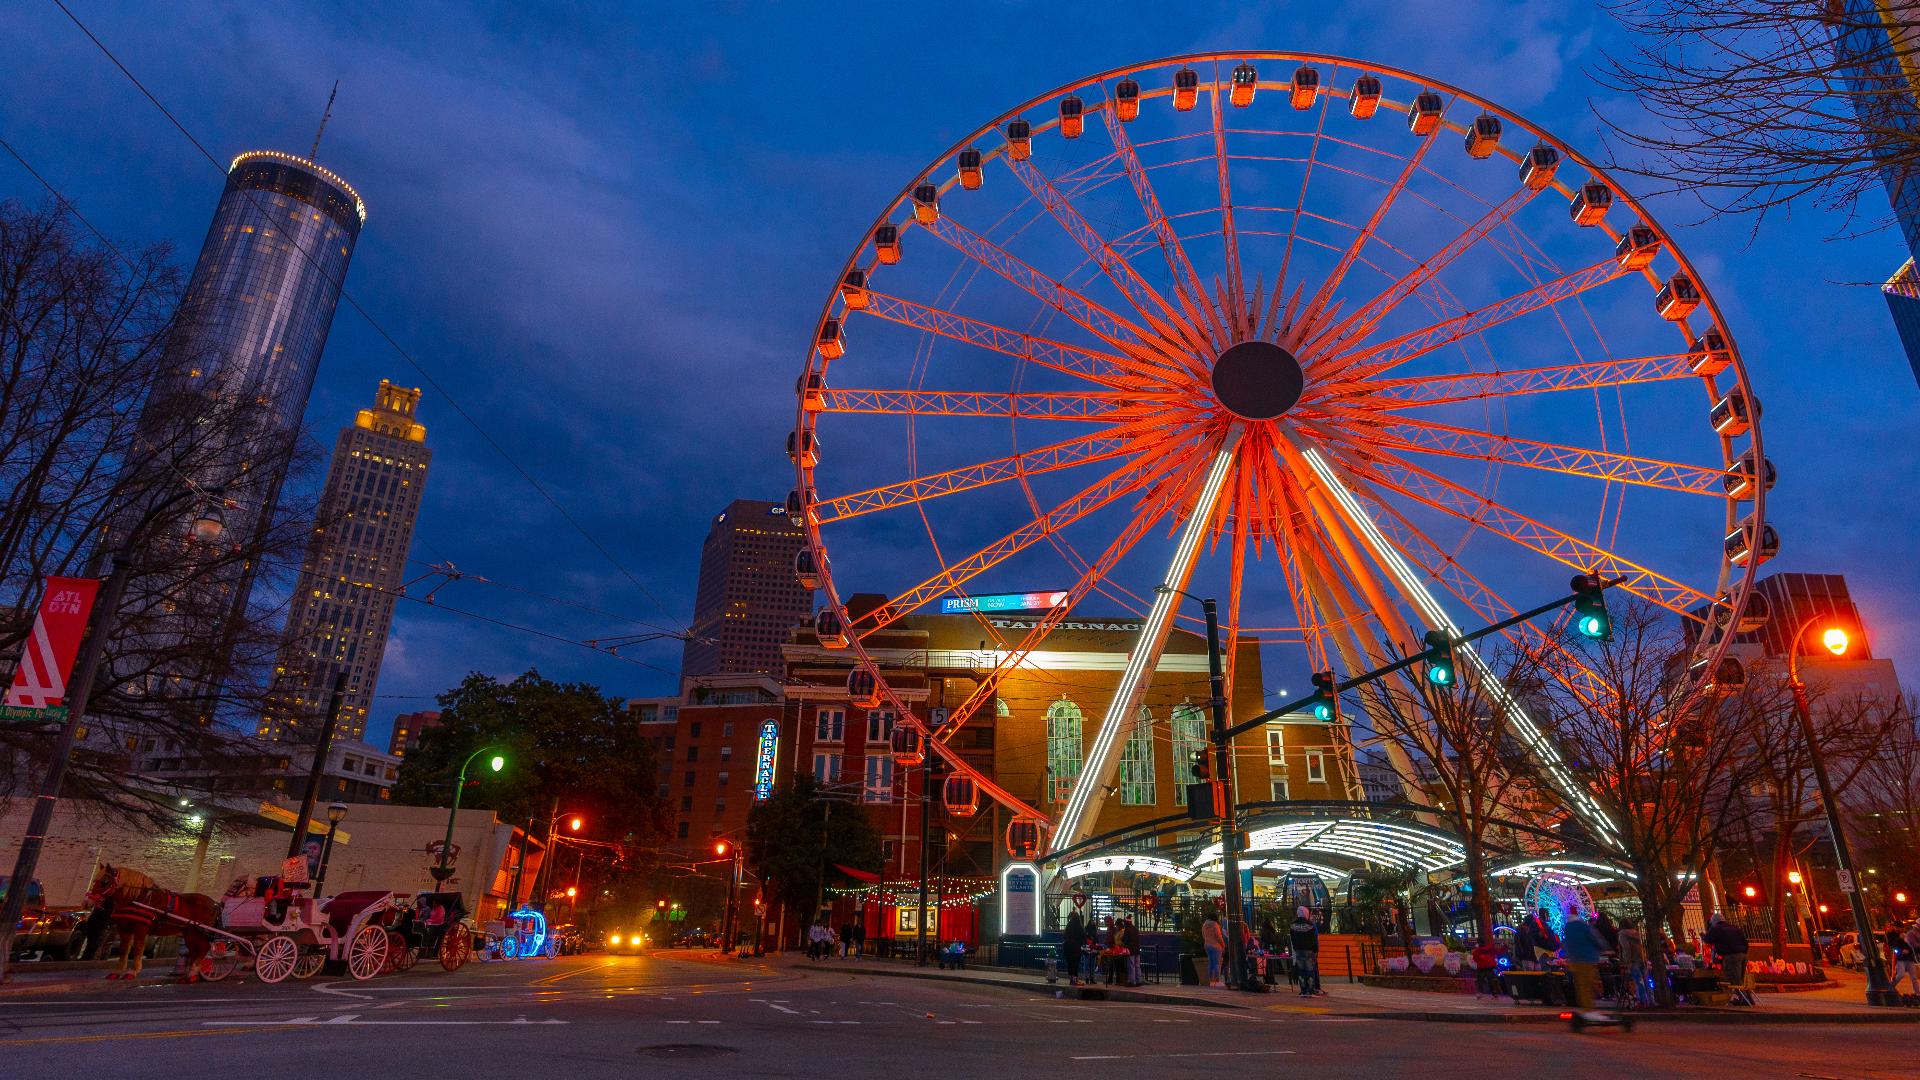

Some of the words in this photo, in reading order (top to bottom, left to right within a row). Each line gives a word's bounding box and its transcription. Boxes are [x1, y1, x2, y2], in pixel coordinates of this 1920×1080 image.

[52, 590, 81, 603] ATL
[48, 601, 81, 614] DTN
[946, 598, 979, 609] PRISM
[936, 709, 944, 723] 5
[760, 724, 775, 799] TABERNACLE
